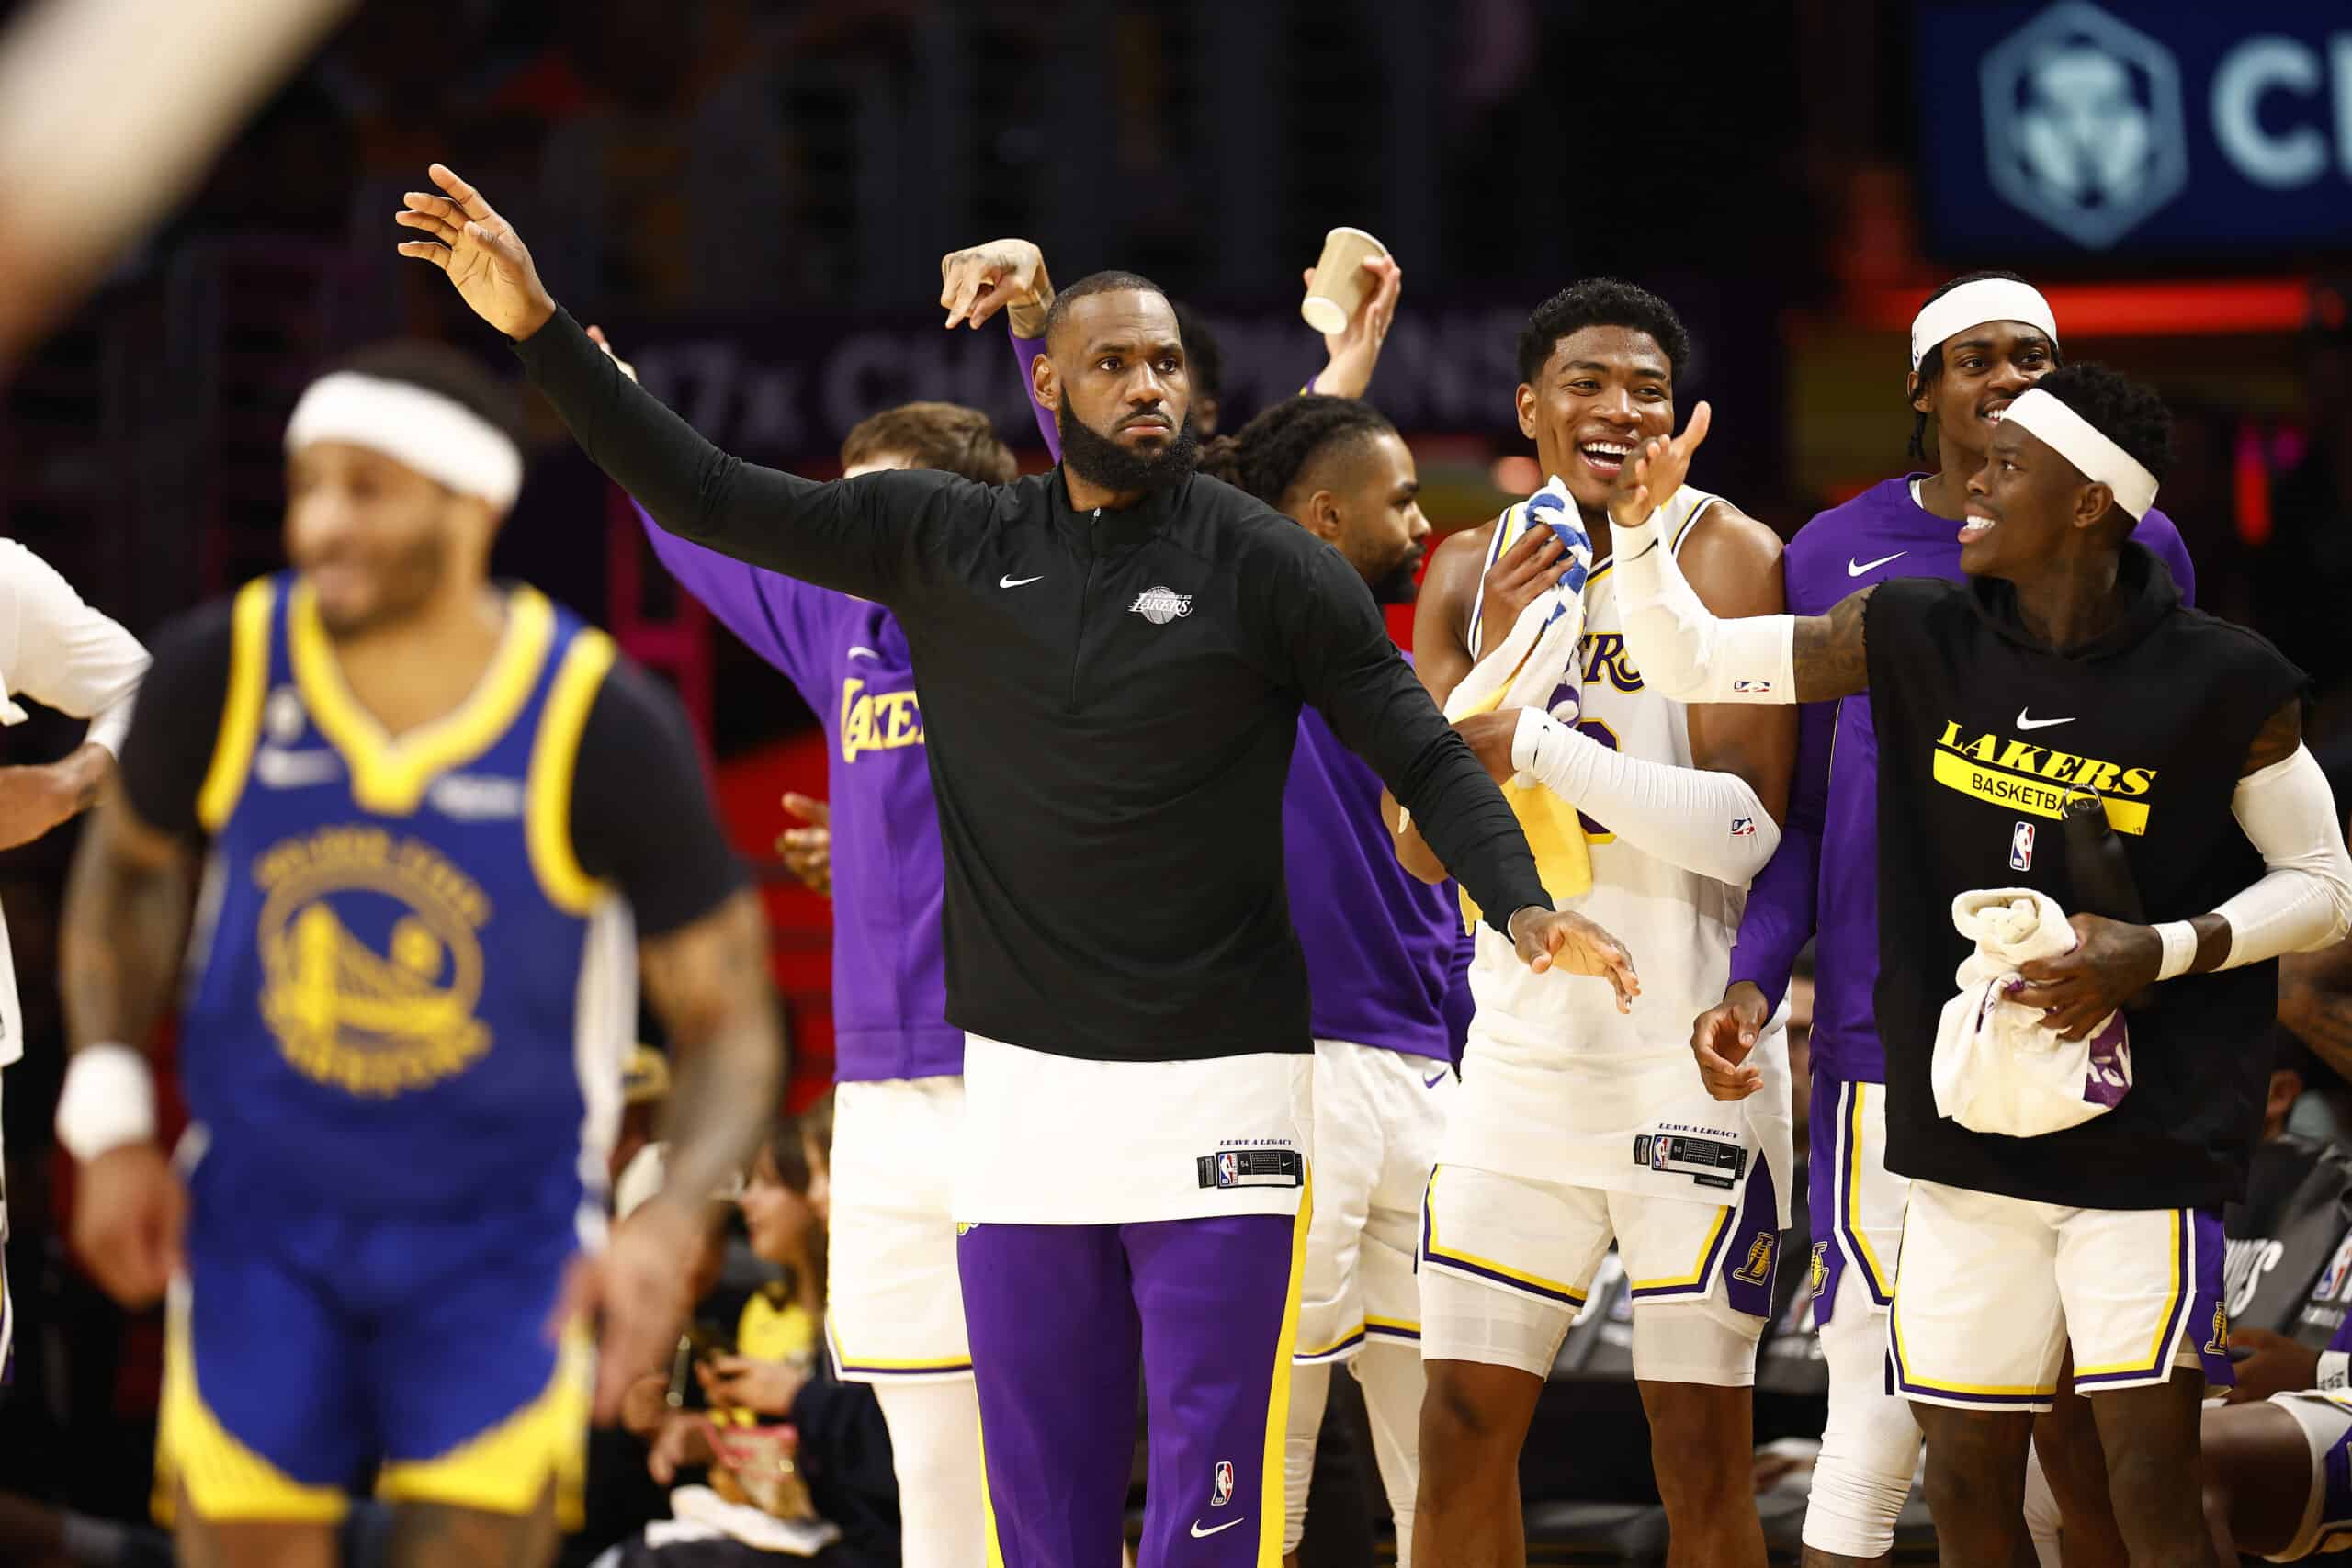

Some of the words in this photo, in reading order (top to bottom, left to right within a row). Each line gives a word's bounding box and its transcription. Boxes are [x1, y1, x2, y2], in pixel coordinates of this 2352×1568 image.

[2209, 34, 2352, 190] C
[841, 677, 925, 764] LAKE
[1937, 719, 2158, 795] LAKERS
[1700, 1127, 1737, 1138] LEGACY
